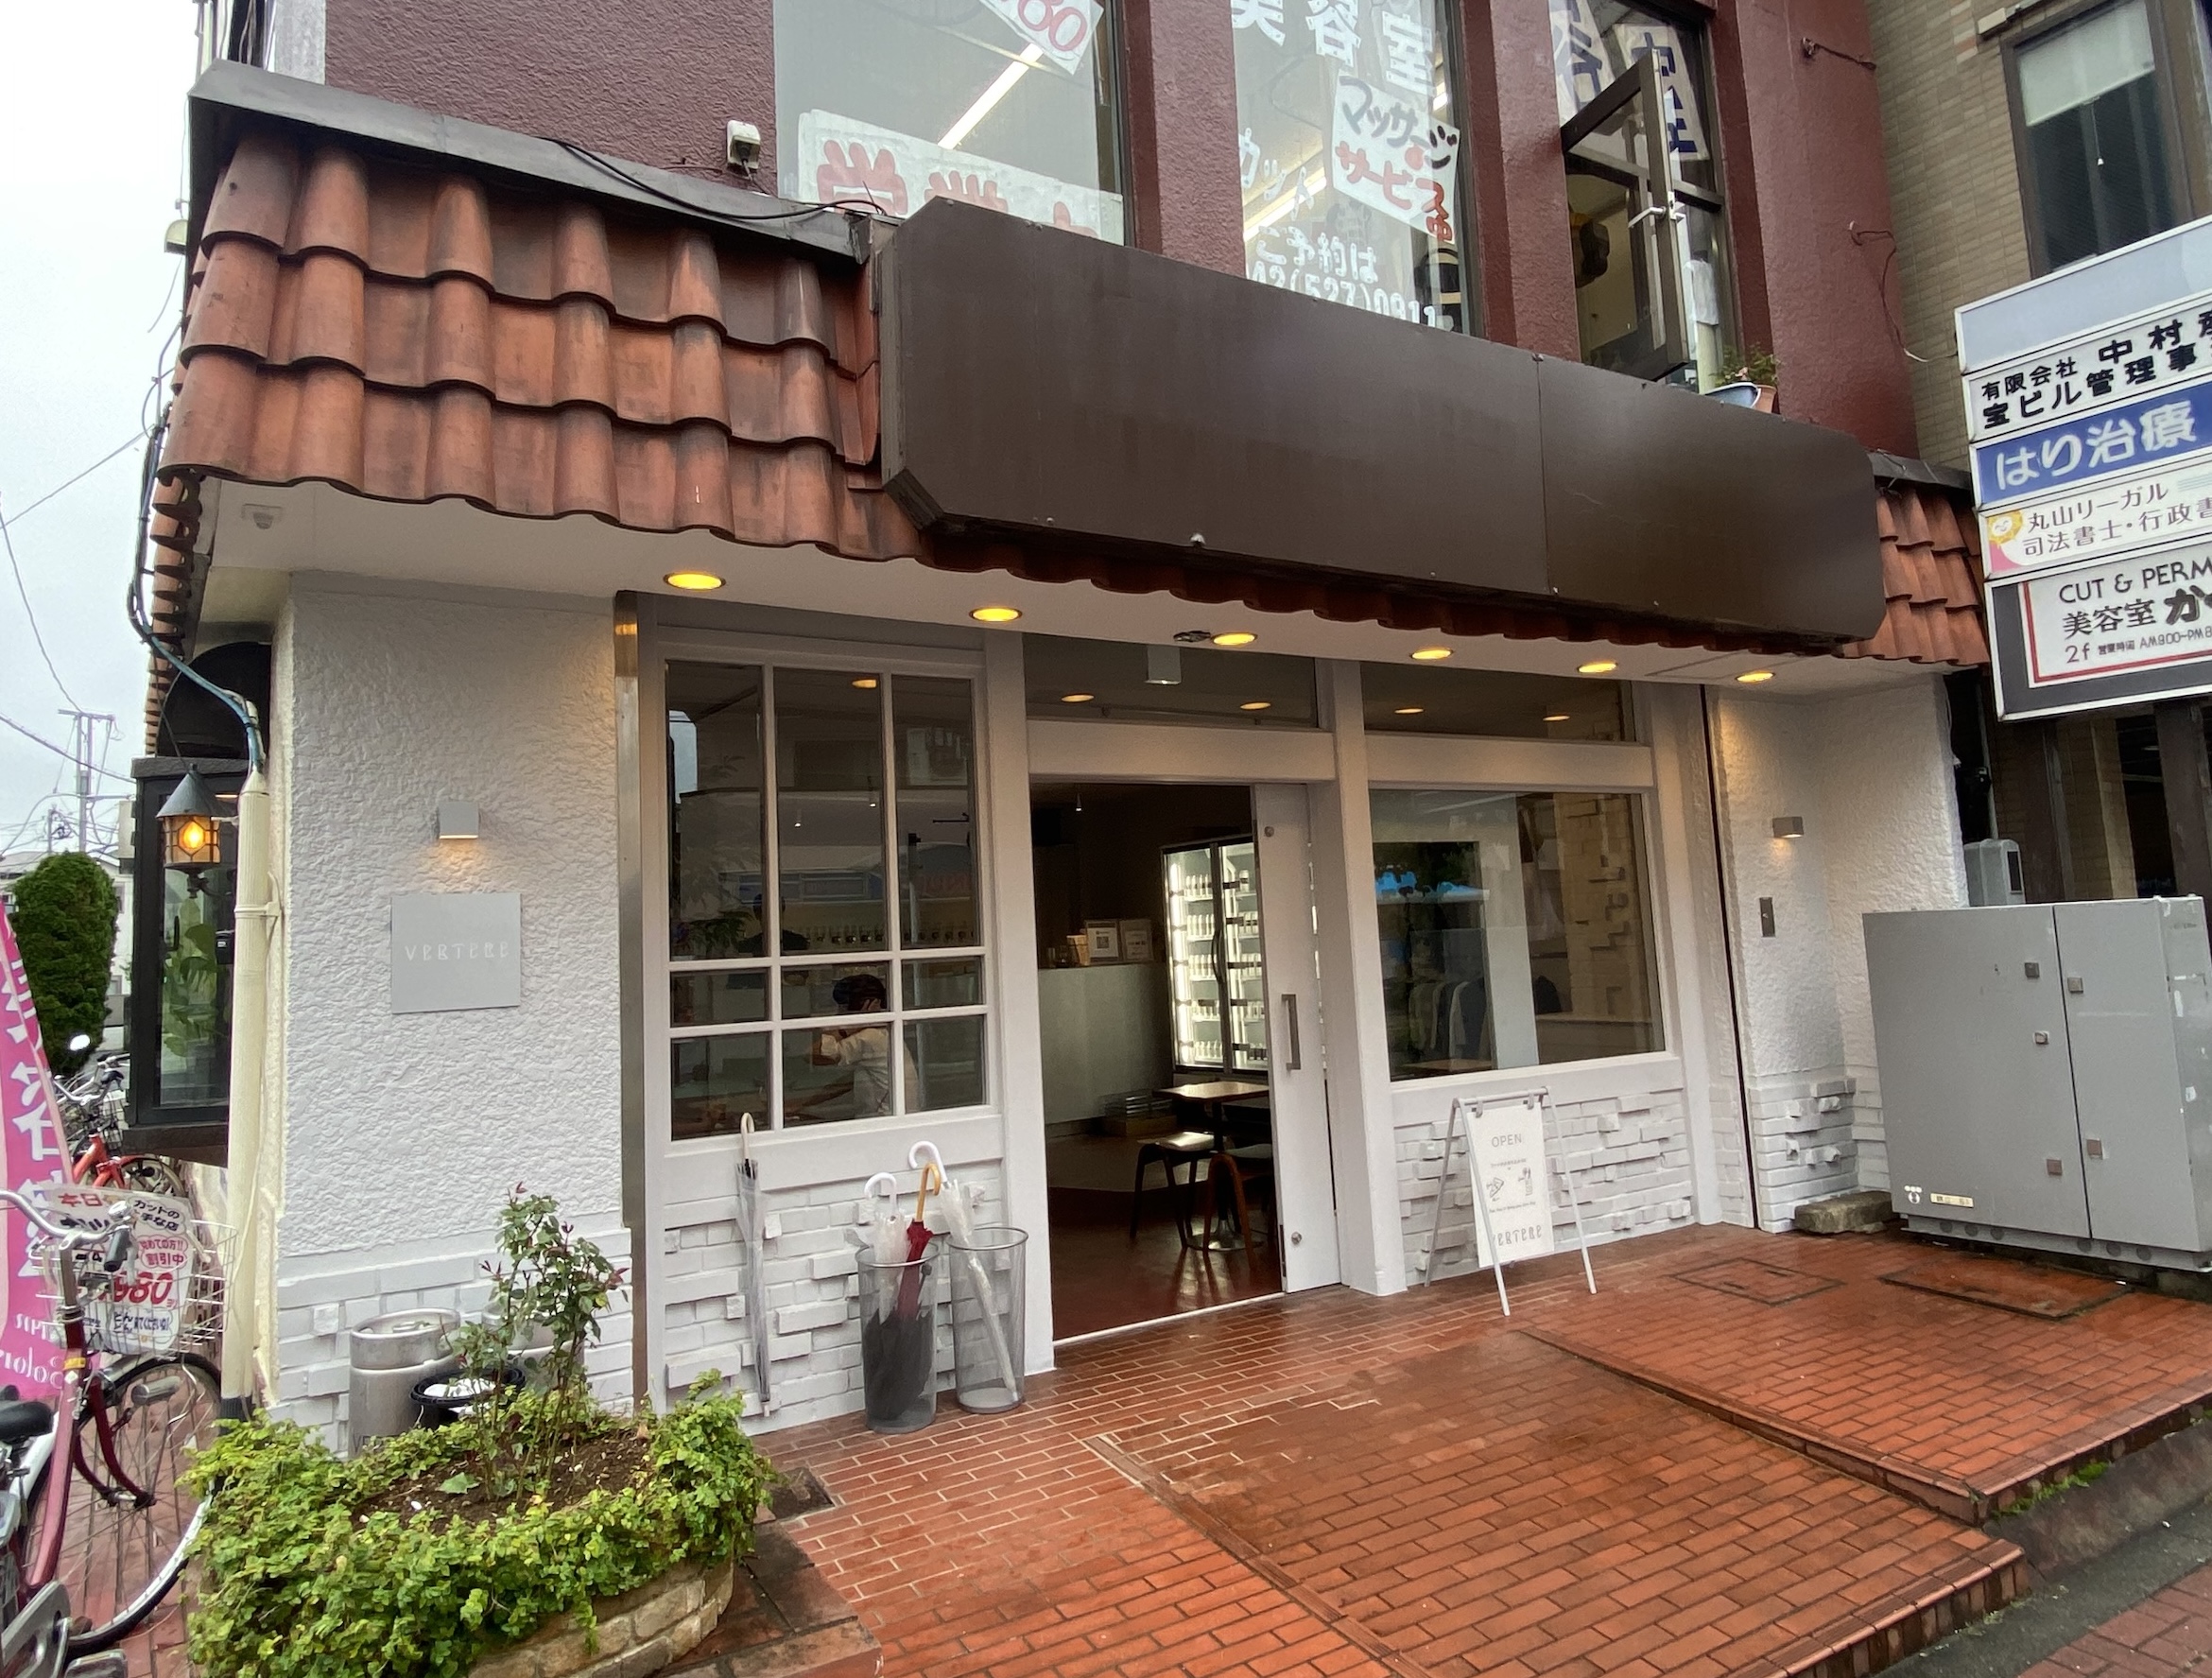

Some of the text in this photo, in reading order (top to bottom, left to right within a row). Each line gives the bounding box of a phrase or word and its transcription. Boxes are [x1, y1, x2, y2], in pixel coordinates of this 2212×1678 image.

[1255, 225, 1379, 284] ご予約は
[1981, 356, 2079, 401] 有限会社
[1983, 342, 2212, 429] 宝ビル管理事
[2027, 482, 2169, 533] 丸山リーガル
[2059, 556, 2212, 604] CUT & PERM
[2062, 584, 2212, 641] 美容室 か
[1491, 1133, 1523, 1148] OPEN
[133, 1200, 181, 1220] カットの
